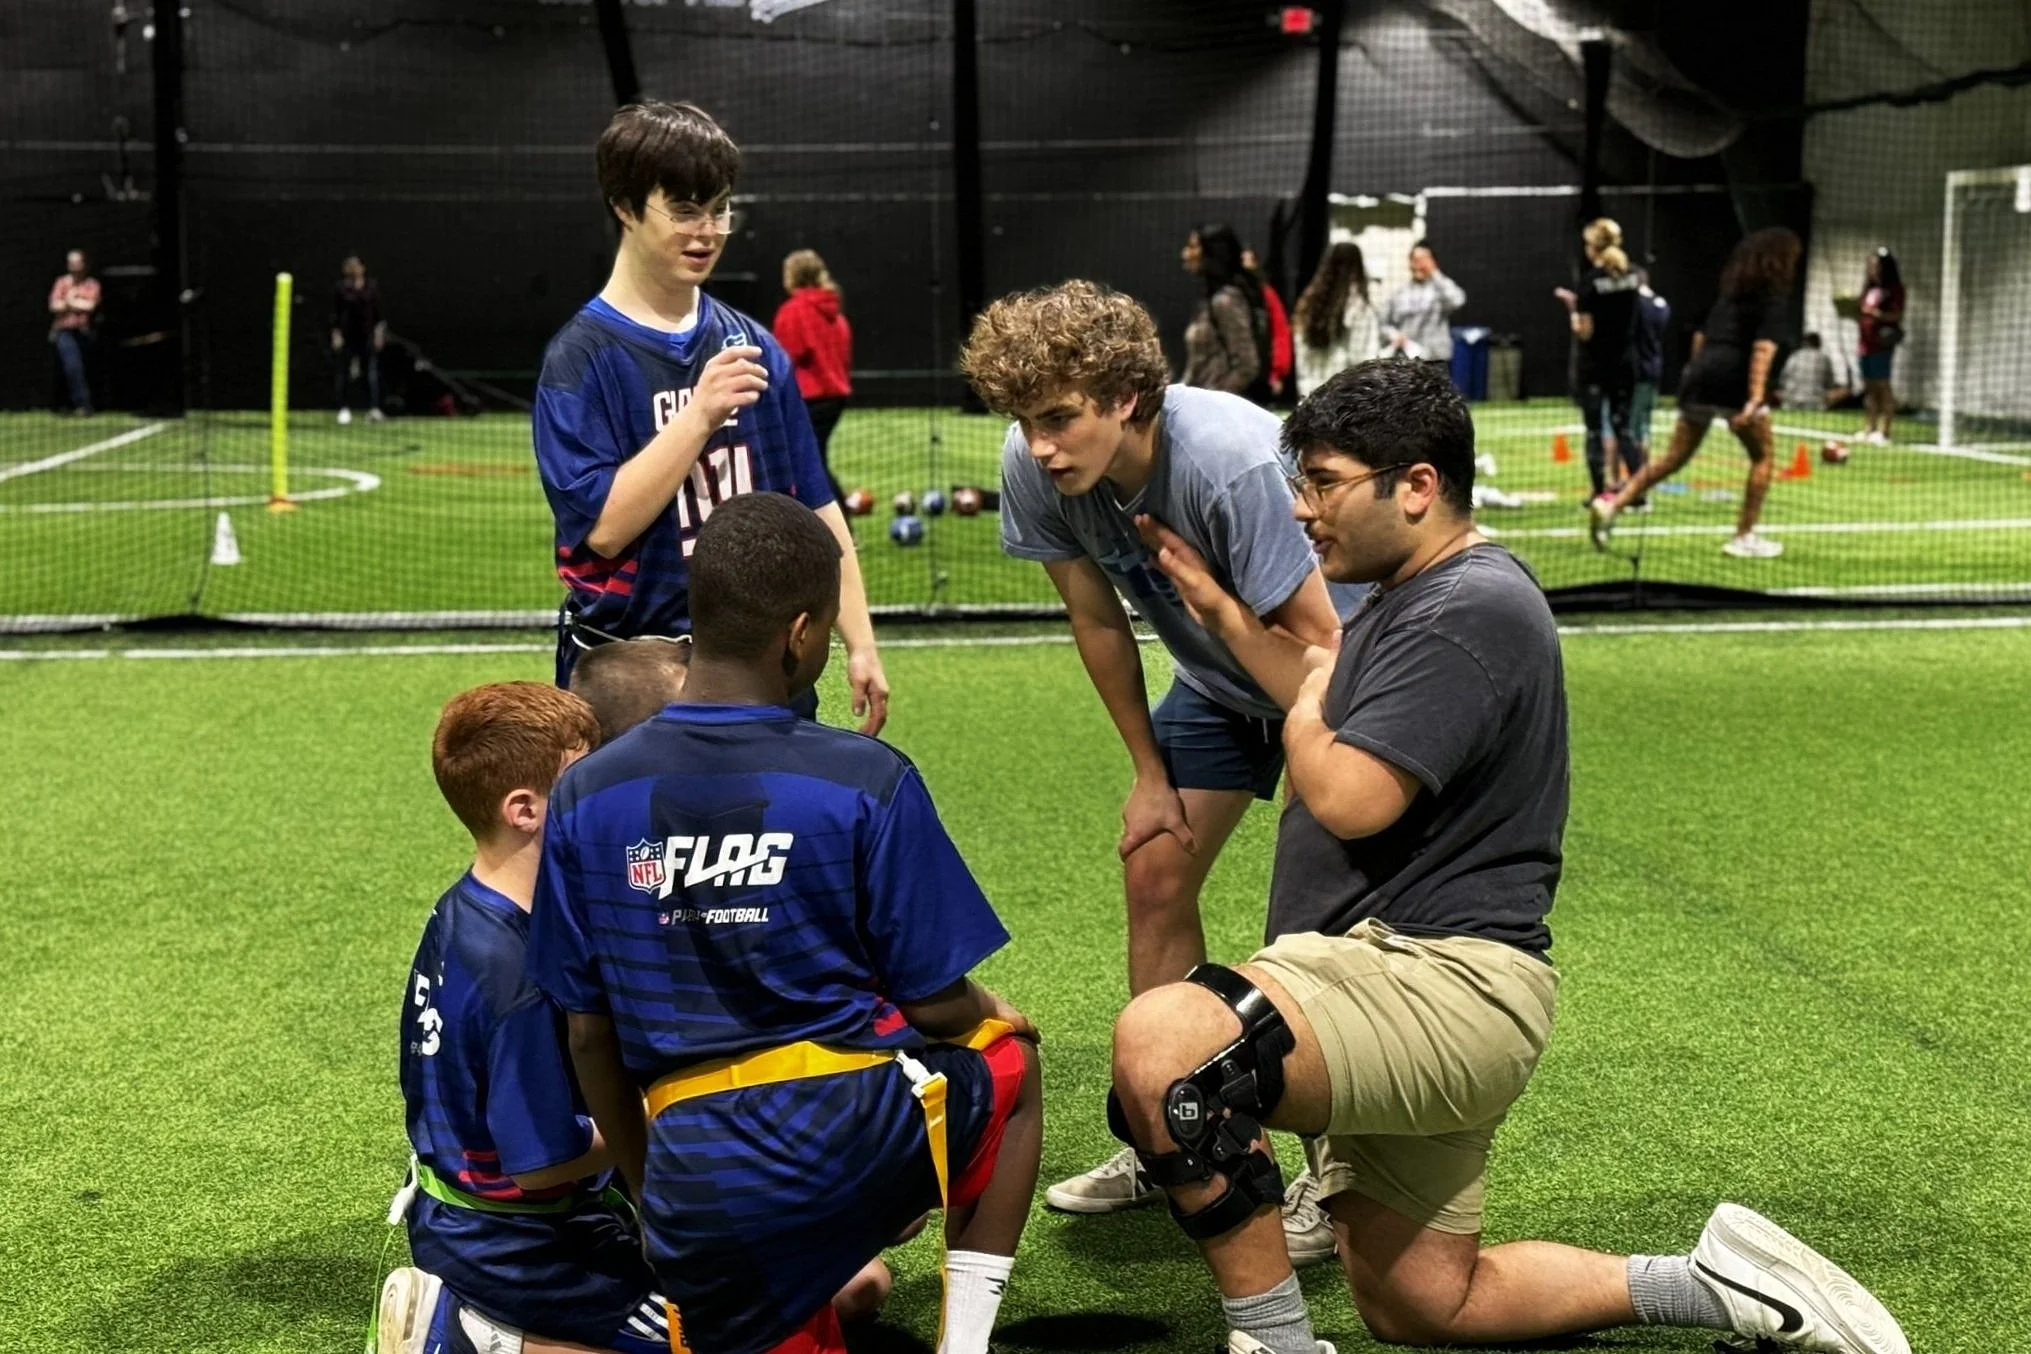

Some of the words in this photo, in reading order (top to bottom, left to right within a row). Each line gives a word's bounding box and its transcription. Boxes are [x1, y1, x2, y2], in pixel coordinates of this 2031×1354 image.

[632, 862, 663, 885] NFL
[658, 833, 794, 900] FLAG
[705, 908, 769, 924] FOOTBALL
